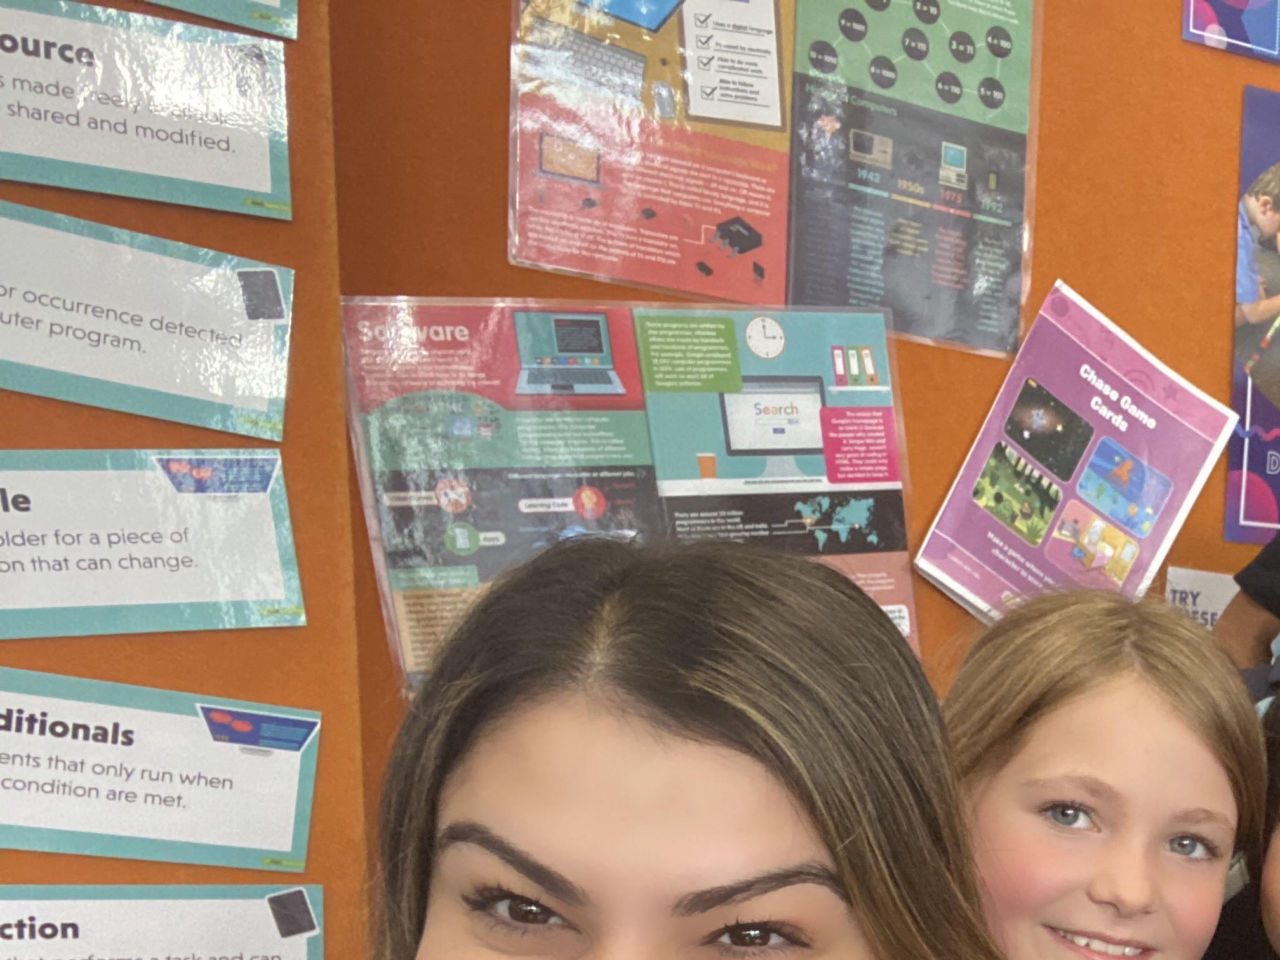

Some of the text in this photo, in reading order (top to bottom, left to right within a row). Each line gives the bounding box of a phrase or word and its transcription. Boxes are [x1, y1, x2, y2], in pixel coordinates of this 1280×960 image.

[12, 77, 75, 99] made
[7, 100, 236, 154] shared and modified.
[22, 290, 144, 327] occurrence
[149, 315, 242, 348] detected
[49, 322, 147, 354] program.
[754, 402, 799, 416] Search
[1079, 363, 1157, 430] Chase Game
[1090, 396, 1129, 432] Cards
[54, 529, 83, 546] for
[89, 533, 100, 546] a
[107, 528, 163, 549] piece
[169, 527, 190, 544] of
[31, 555, 69, 572] that
[76, 557, 112, 571] can
[118, 553, 199, 572] change.
[1170, 589, 1202, 607] TRY
[48, 755, 86, 773] that
[92, 762, 136, 782] only
[141, 768, 173, 783] run
[179, 772, 234, 791] when
[1, 776, 187, 810] condition are met.
